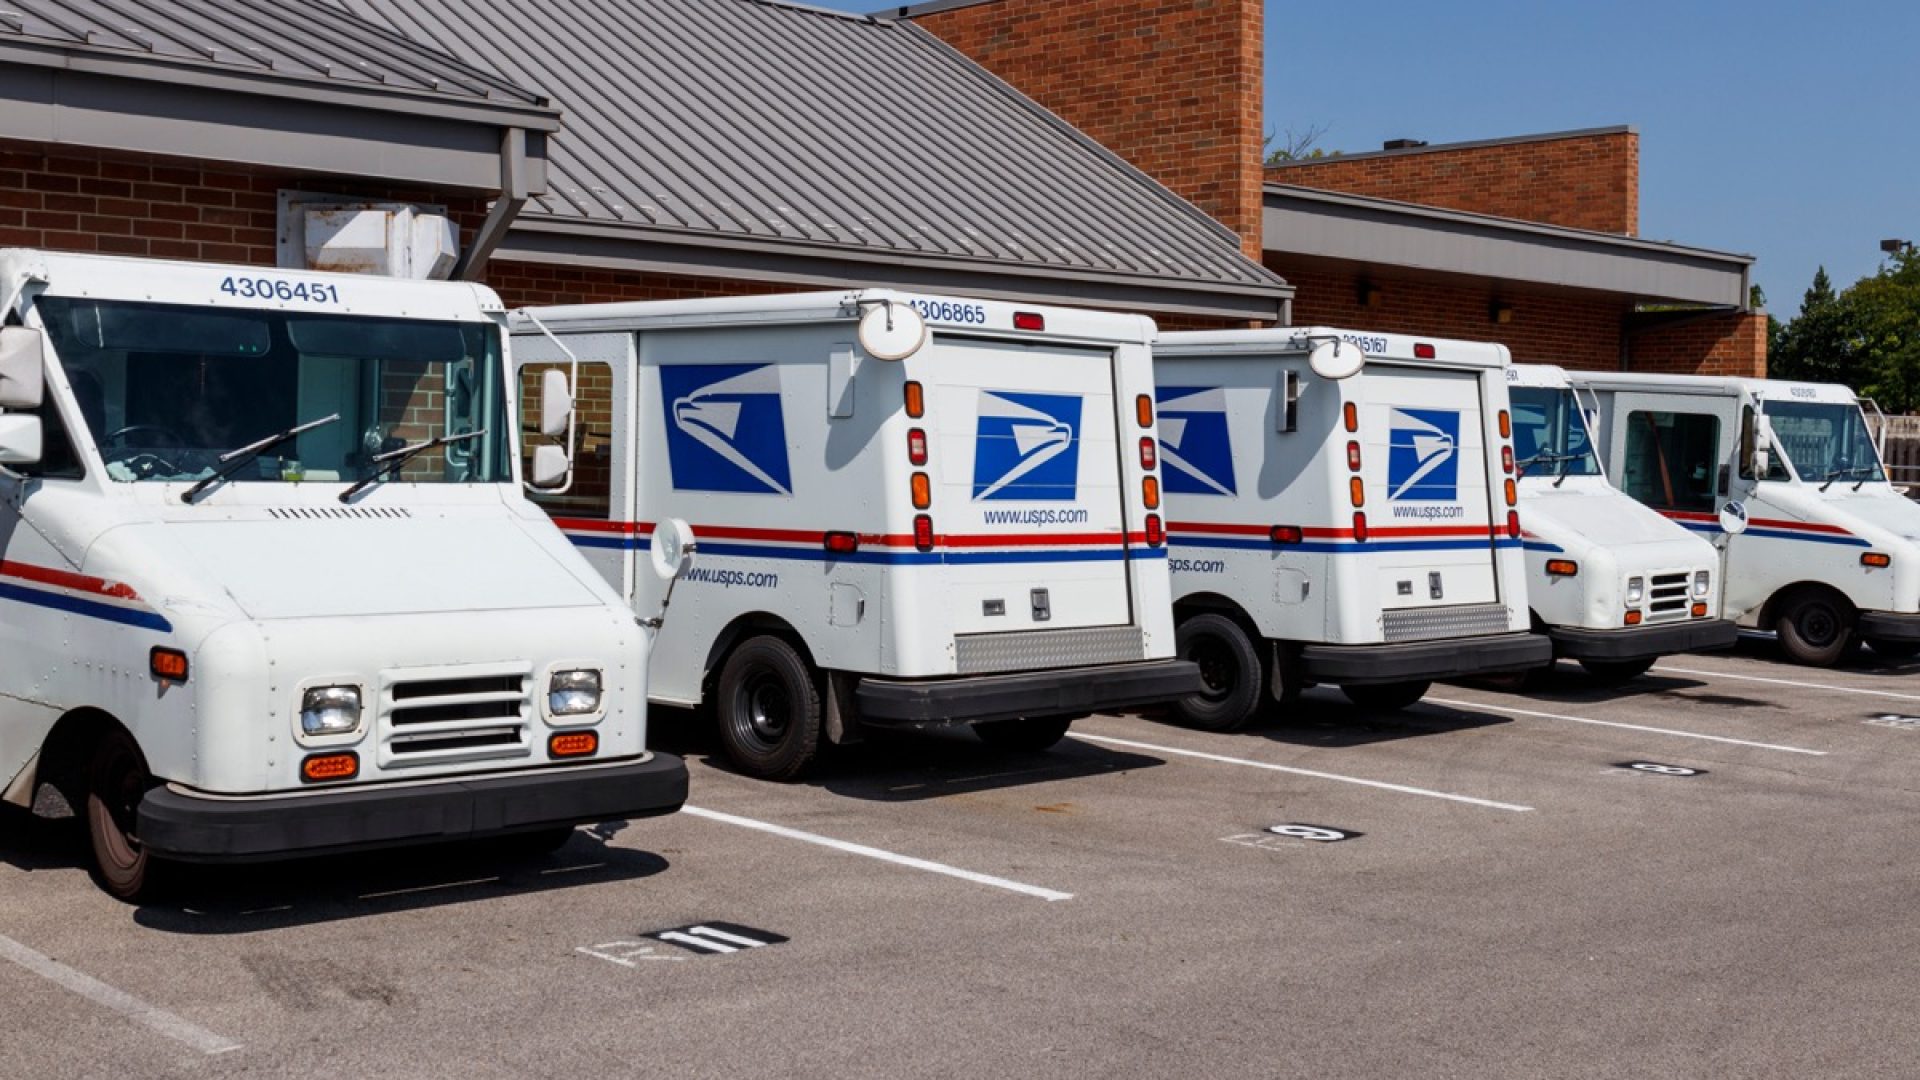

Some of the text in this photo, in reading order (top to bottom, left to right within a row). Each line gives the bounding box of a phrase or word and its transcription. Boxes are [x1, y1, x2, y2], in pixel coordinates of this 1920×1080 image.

[220, 276, 339, 303] 4306451
[983, 509, 1088, 527] www.usps.com
[1393, 506, 1464, 521] www.usps.com
[682, 567, 778, 588] ww.usps.com
[658, 925, 769, 954] 11
